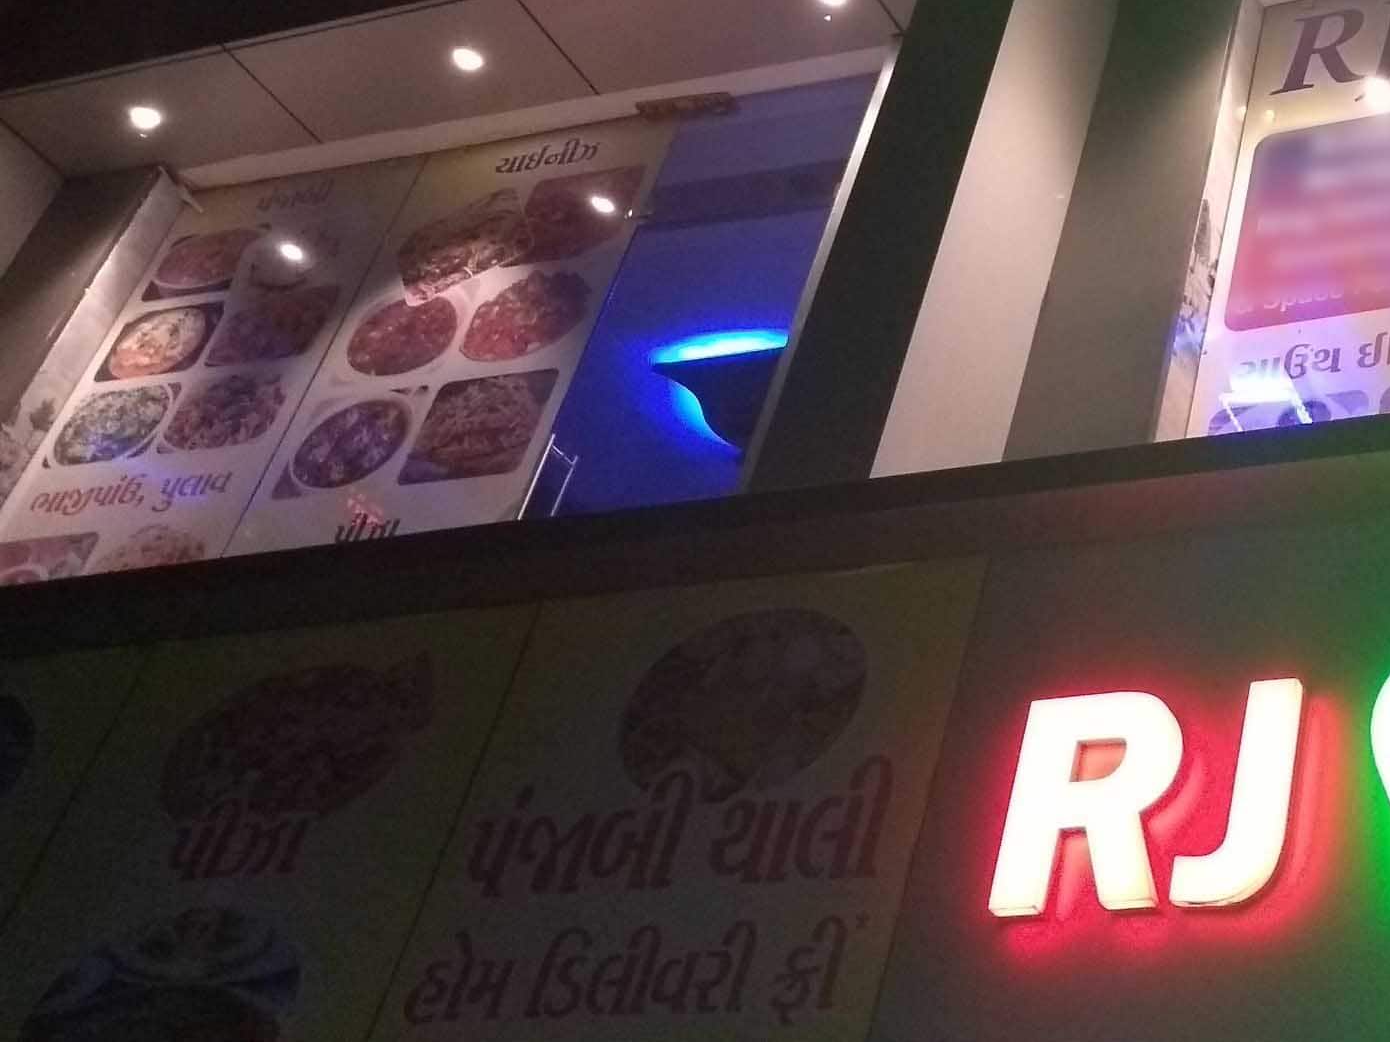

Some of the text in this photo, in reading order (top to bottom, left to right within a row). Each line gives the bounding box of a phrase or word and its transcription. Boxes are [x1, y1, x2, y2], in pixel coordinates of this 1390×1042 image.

[466, 769, 694, 897] પંજાબી
[987, 677, 1304, 917] RJ
[404, 930, 515, 1025] હોમ
[524, 920, 757, 1020] ડિલીવરી
